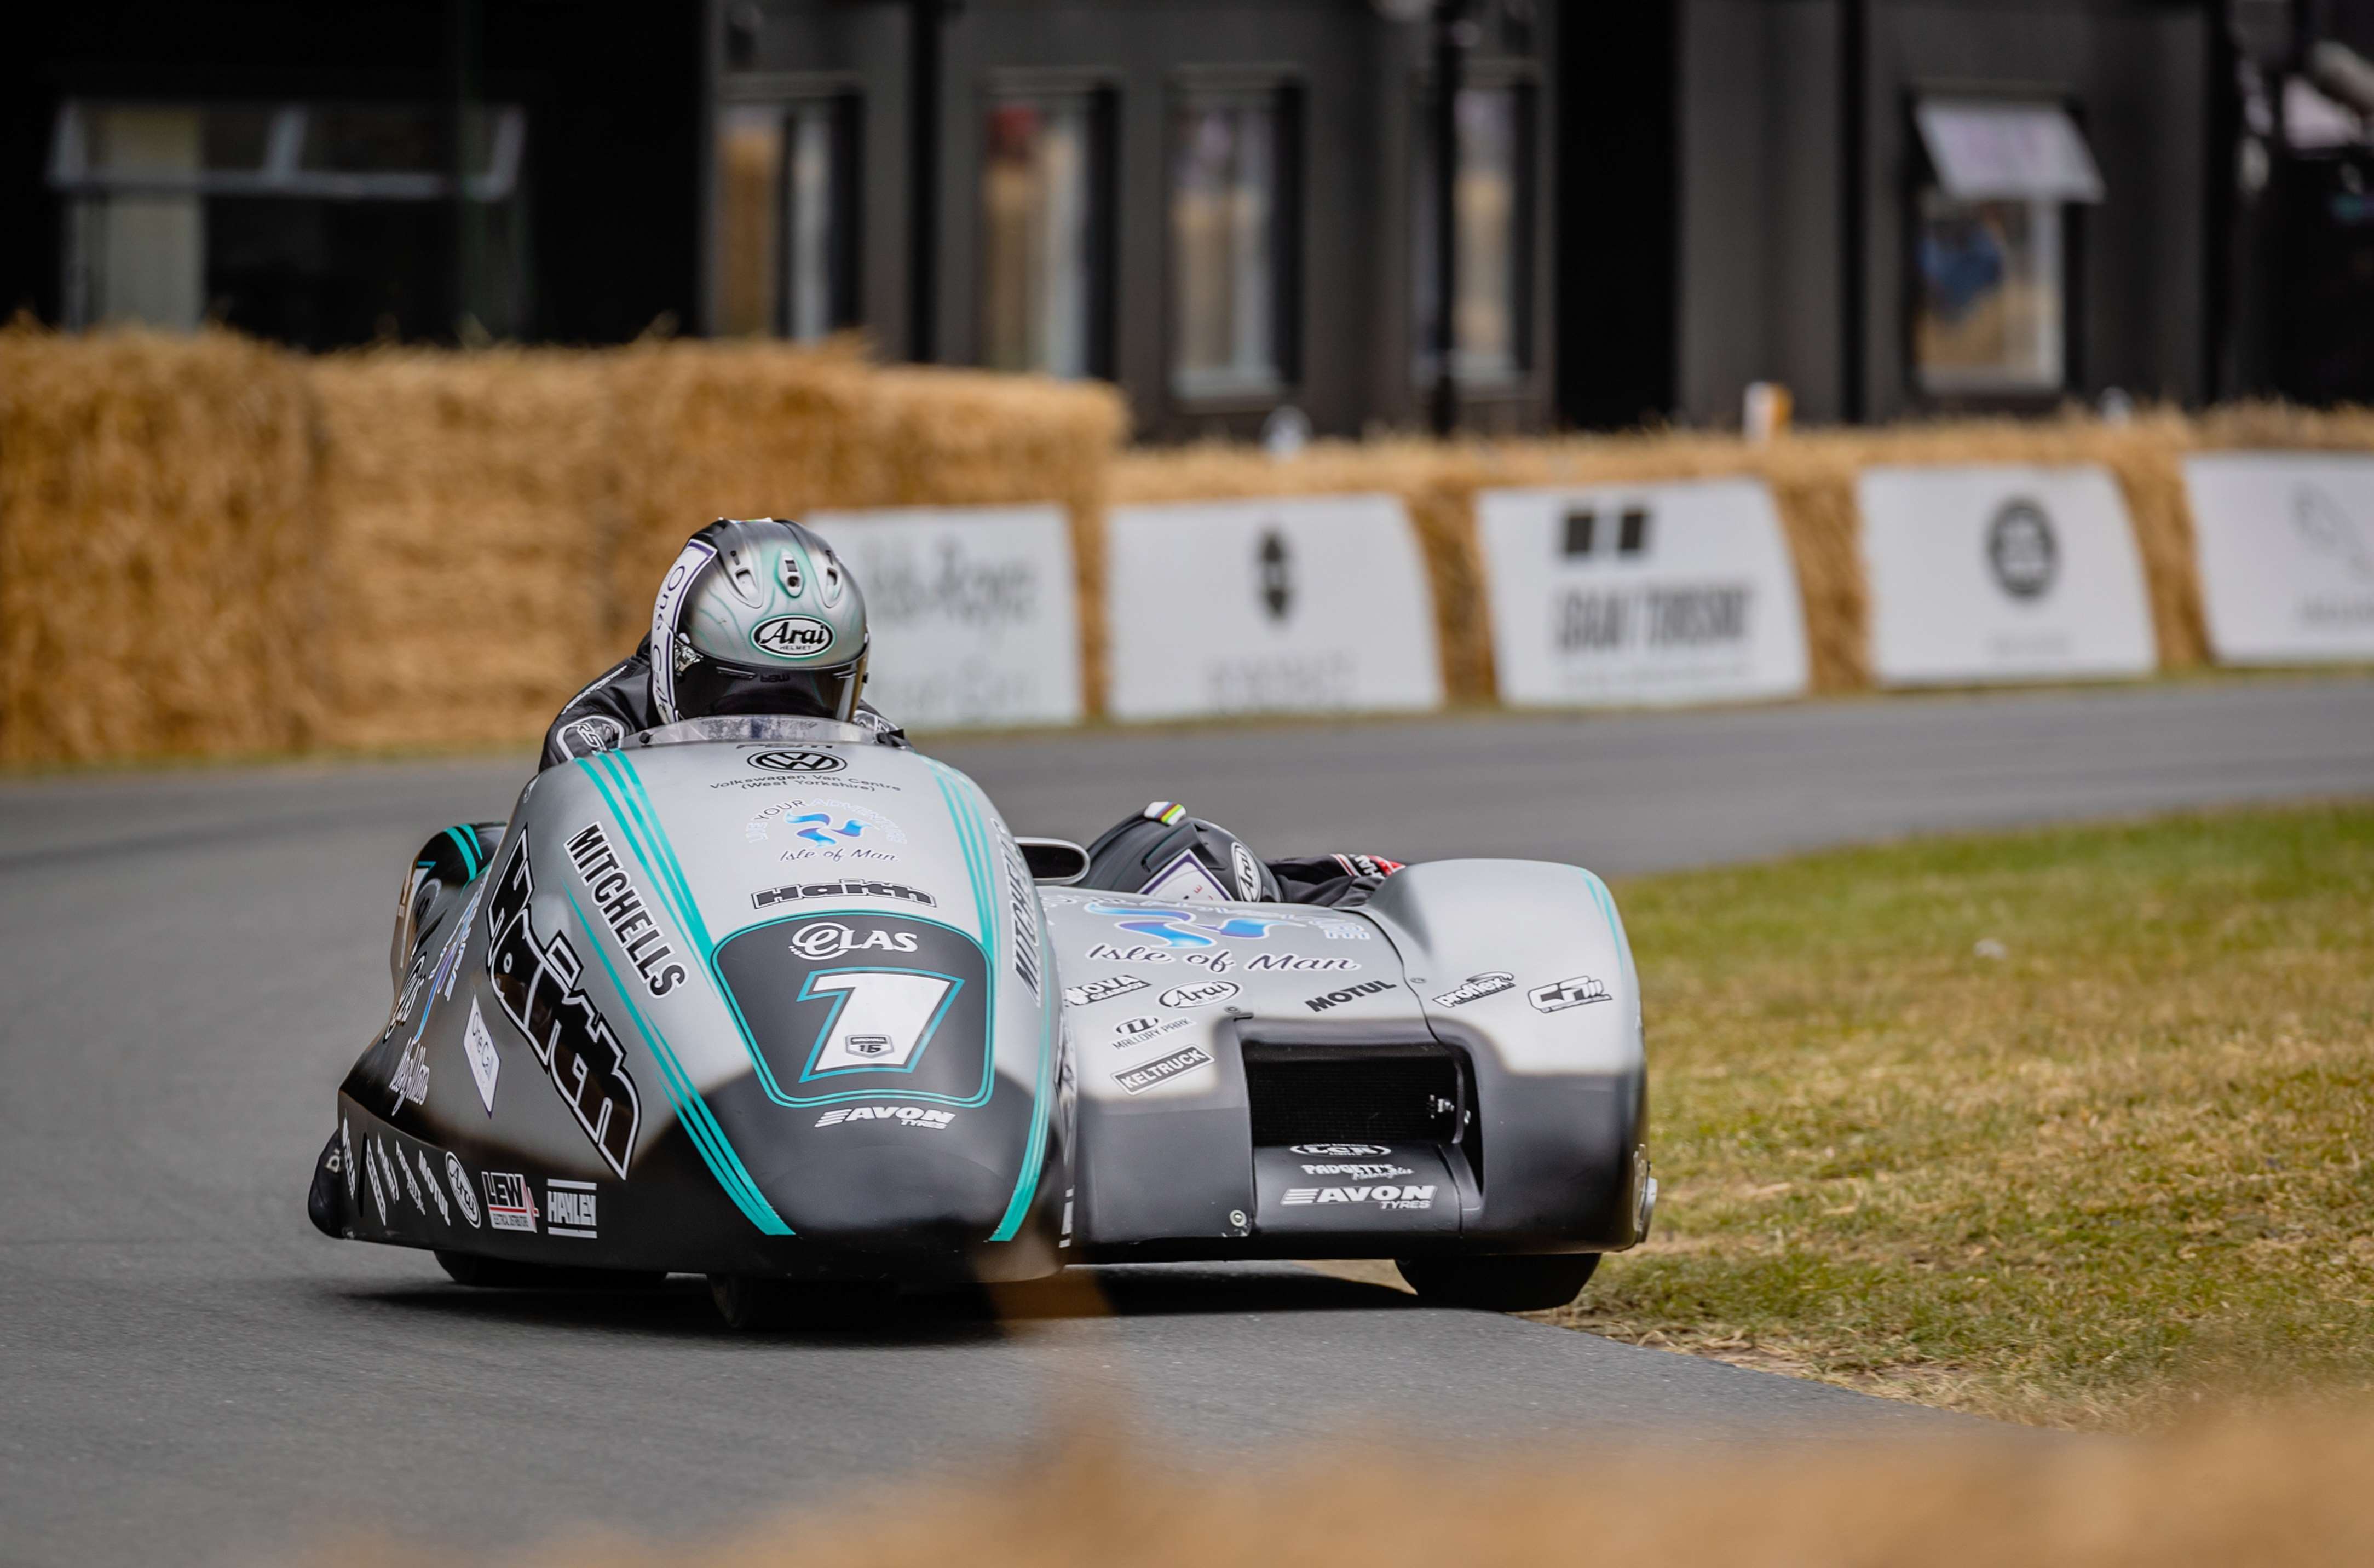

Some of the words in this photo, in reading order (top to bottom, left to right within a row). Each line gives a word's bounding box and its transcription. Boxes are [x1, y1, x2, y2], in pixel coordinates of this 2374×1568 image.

[760, 621, 825, 644] Arai
[710, 774, 805, 789] Volkswagen
[848, 777, 901, 792] Centre
[741, 780, 787, 790] (West
[794, 780, 876, 792] Yorkshire)
[753, 799, 806, 820] YOUR
[780, 848, 817, 861] Isle
[823, 848, 845, 862] of
[851, 849, 898, 862] Man
[751, 879, 937, 909] Haith
[563, 821, 689, 1000] MITCHELLS
[1088, 944, 1172, 962] Isle
[1185, 950, 1234, 972] of
[1248, 954, 1358, 970] Man
[486, 822, 642, 1180] Haith
[1173, 981, 1230, 1006] Arai
[1305, 980, 1397, 1012] MOTUL
[800, 969, 961, 1079] 1
[1112, 1029, 1161, 1050] MALLORY
[1160, 1018, 1189, 1033] PARK
[1120, 1049, 1206, 1089] KELTRUCK
[845, 1106, 956, 1123] AVON
[901, 1119, 948, 1129] TYRES
[1300, 1163, 1394, 1174] PADGETT'S
[419, 1149, 451, 1226] MOTUL
[482, 1171, 526, 1208] LEW
[1316, 1185, 1437, 1202] AVON
[547, 1191, 596, 1226] HAYLEY
[1380, 1200, 1431, 1209] TYRES
